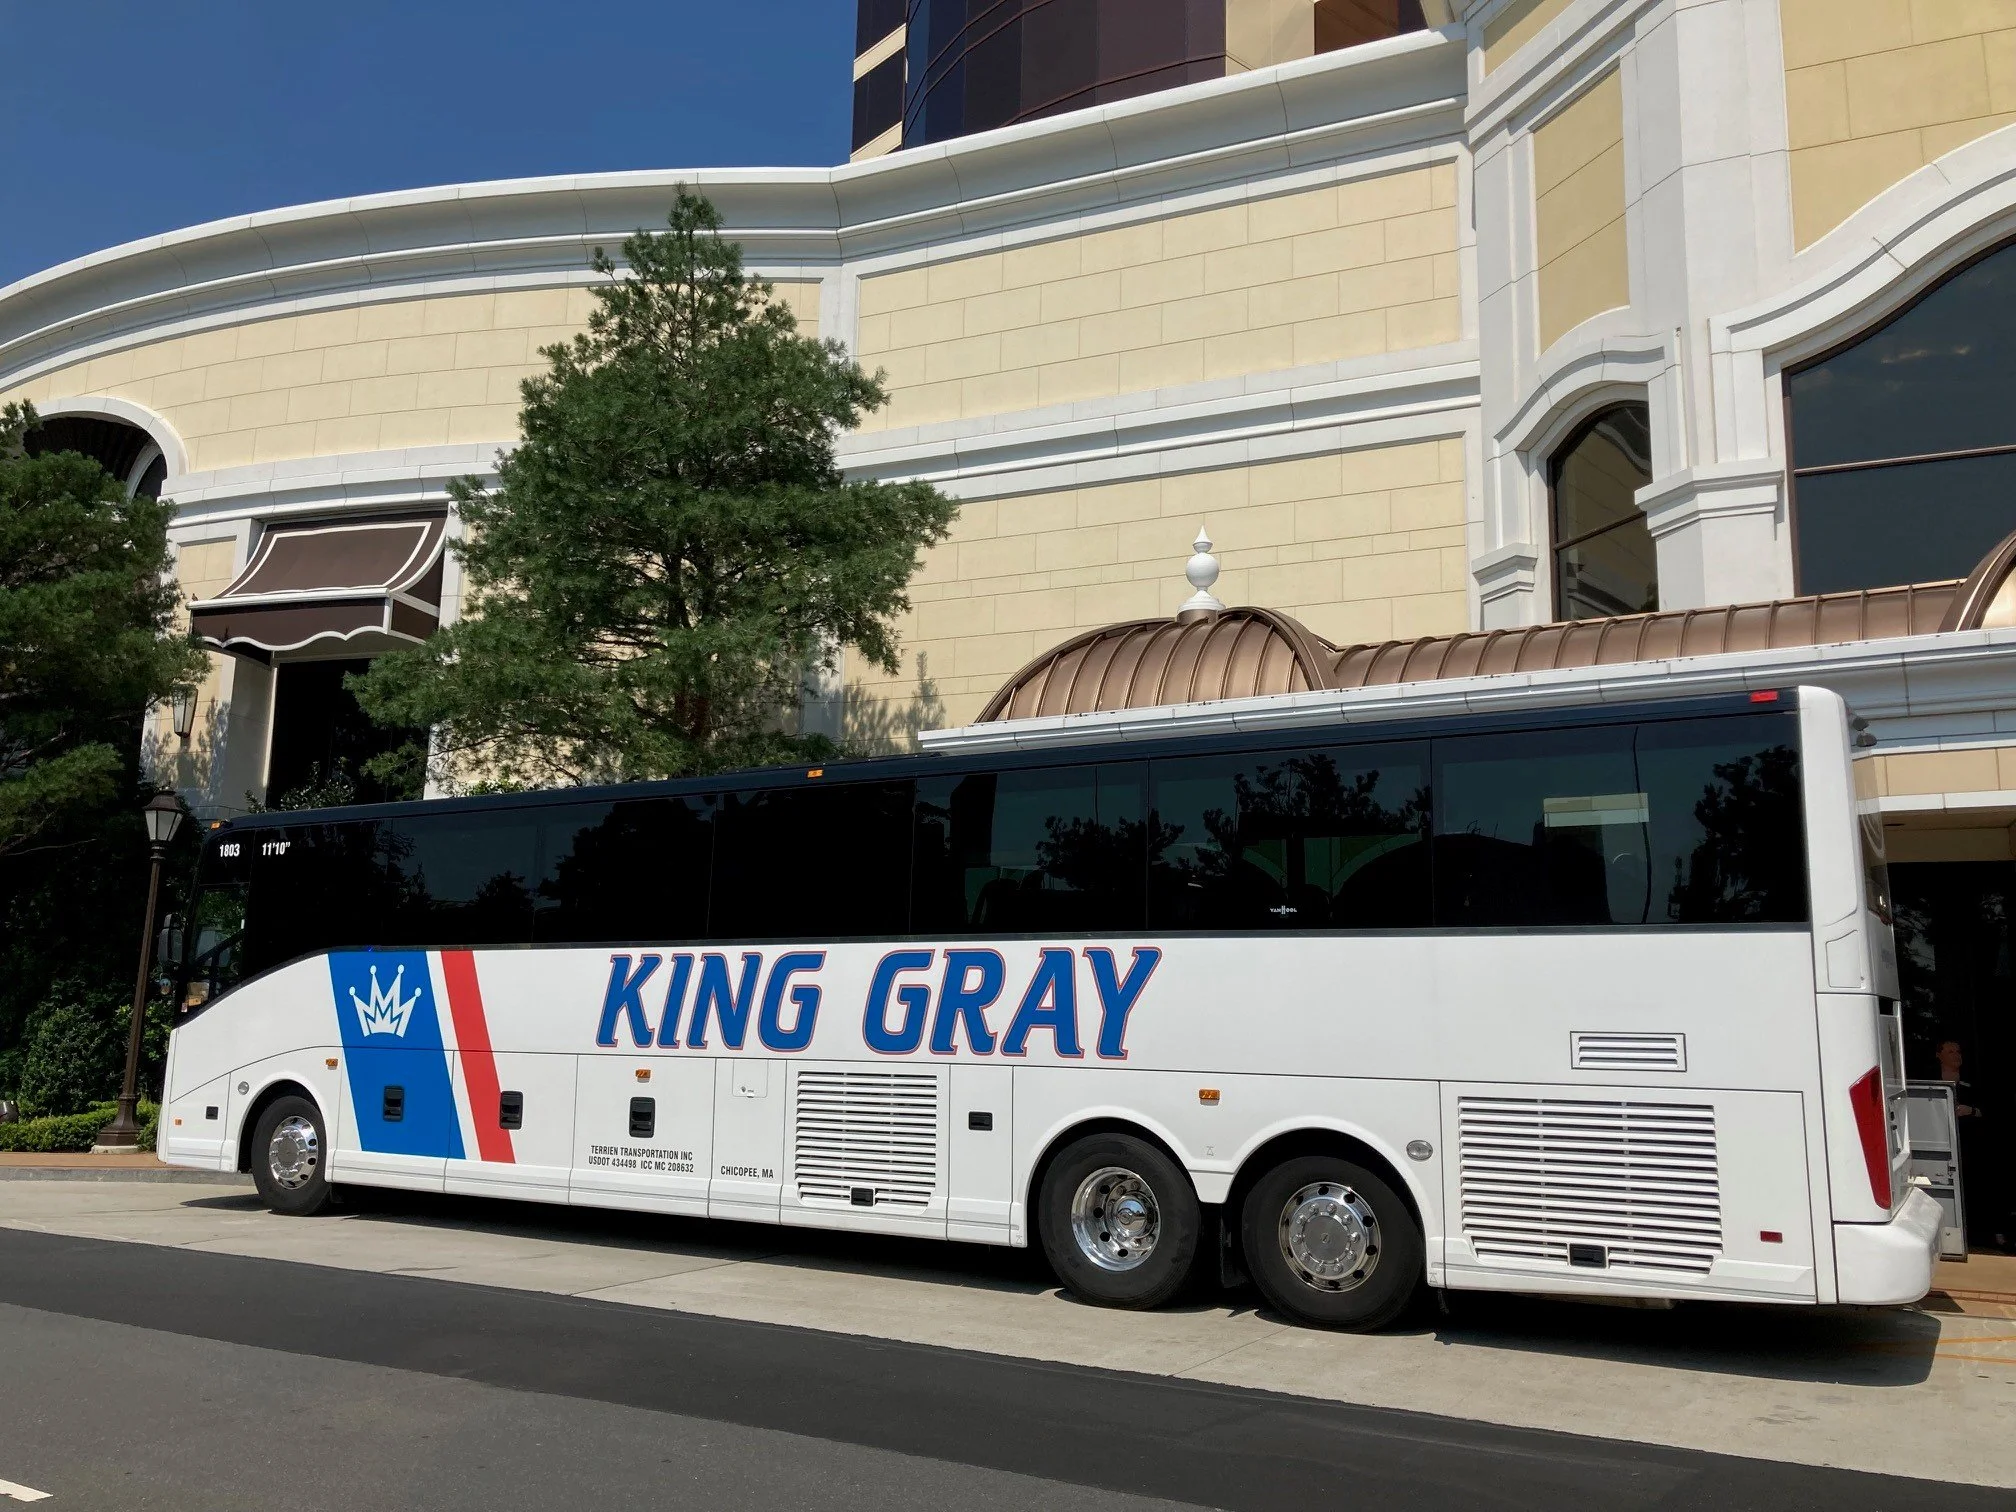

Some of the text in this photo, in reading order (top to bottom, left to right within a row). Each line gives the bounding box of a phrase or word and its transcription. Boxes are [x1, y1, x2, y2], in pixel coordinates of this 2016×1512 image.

[219, 843, 240, 857] 1803
[595, 947, 1163, 1060] KING GRAY
[591, 1145, 693, 1160] TERRIEN TRANSPORTATION INC
[588, 1155, 694, 1173] USDOT 434498 ICC MC 208632
[720, 1165, 774, 1179] CHICOPEE, MA
